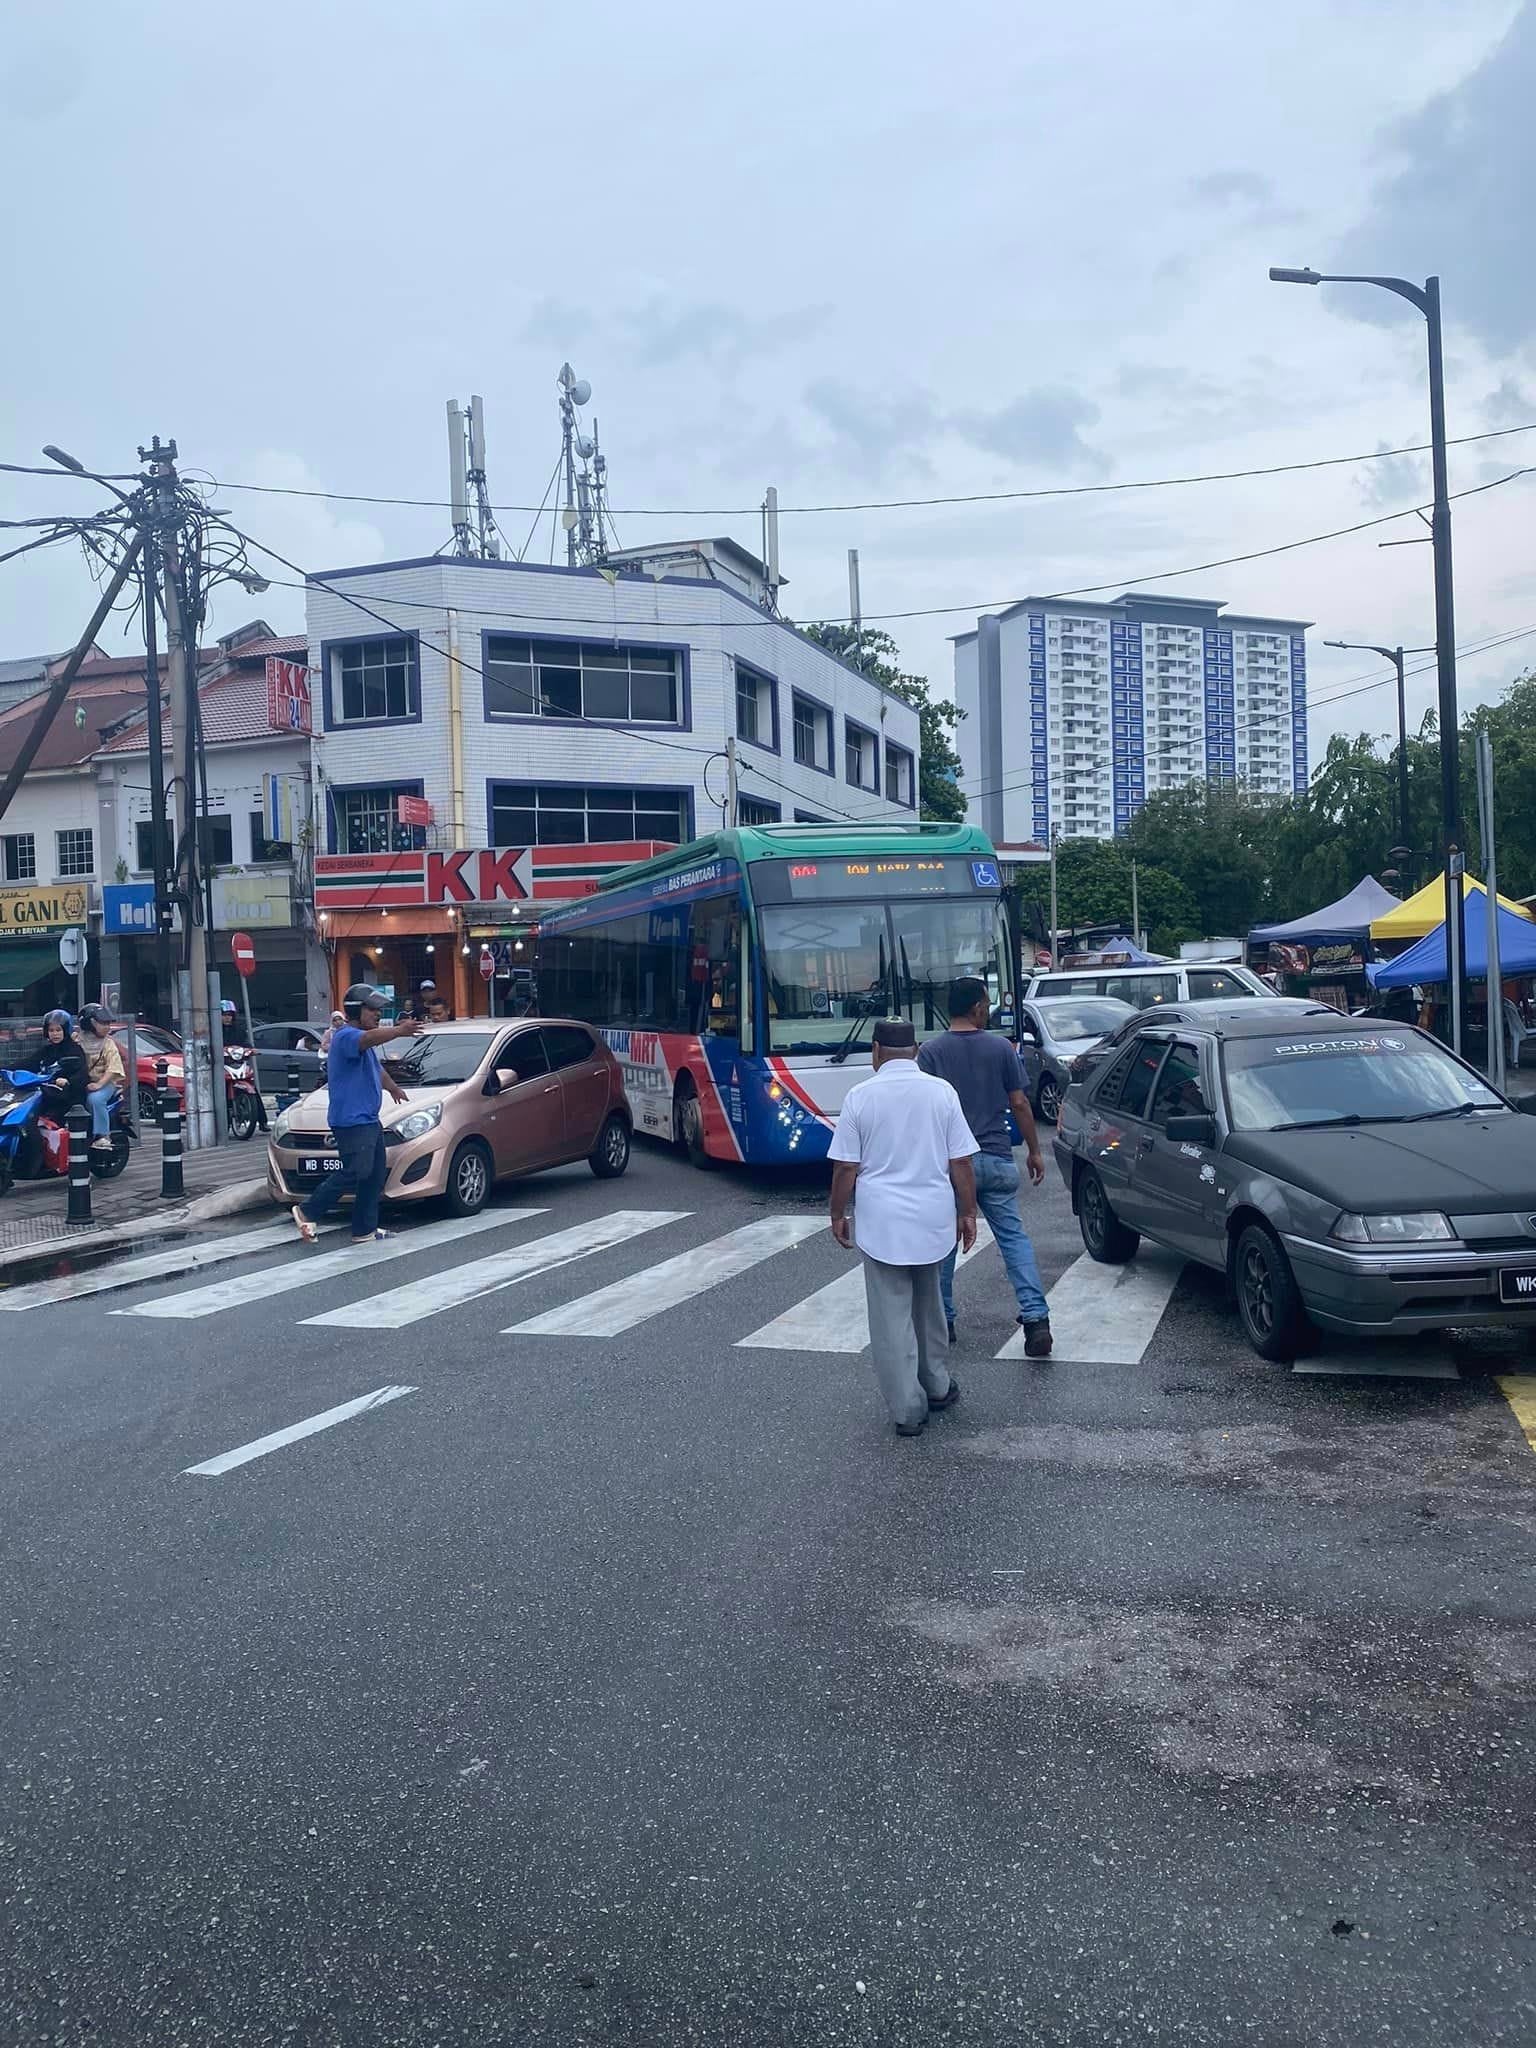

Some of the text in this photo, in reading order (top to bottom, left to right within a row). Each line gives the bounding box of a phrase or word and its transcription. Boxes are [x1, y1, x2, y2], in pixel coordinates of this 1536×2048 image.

[279, 660, 310, 700] KK
[427, 848, 528, 902] KK
[668, 876, 680, 891] BAS
[680, 865, 716, 888] PERANTARA
[13, 899, 59, 923] GANI
[611, 1032, 631, 1054] NAIK
[631, 1033, 658, 1065] MRT
[1275, 1040, 1378, 1053] PROTON
[305, 1159, 317, 1170] WB
